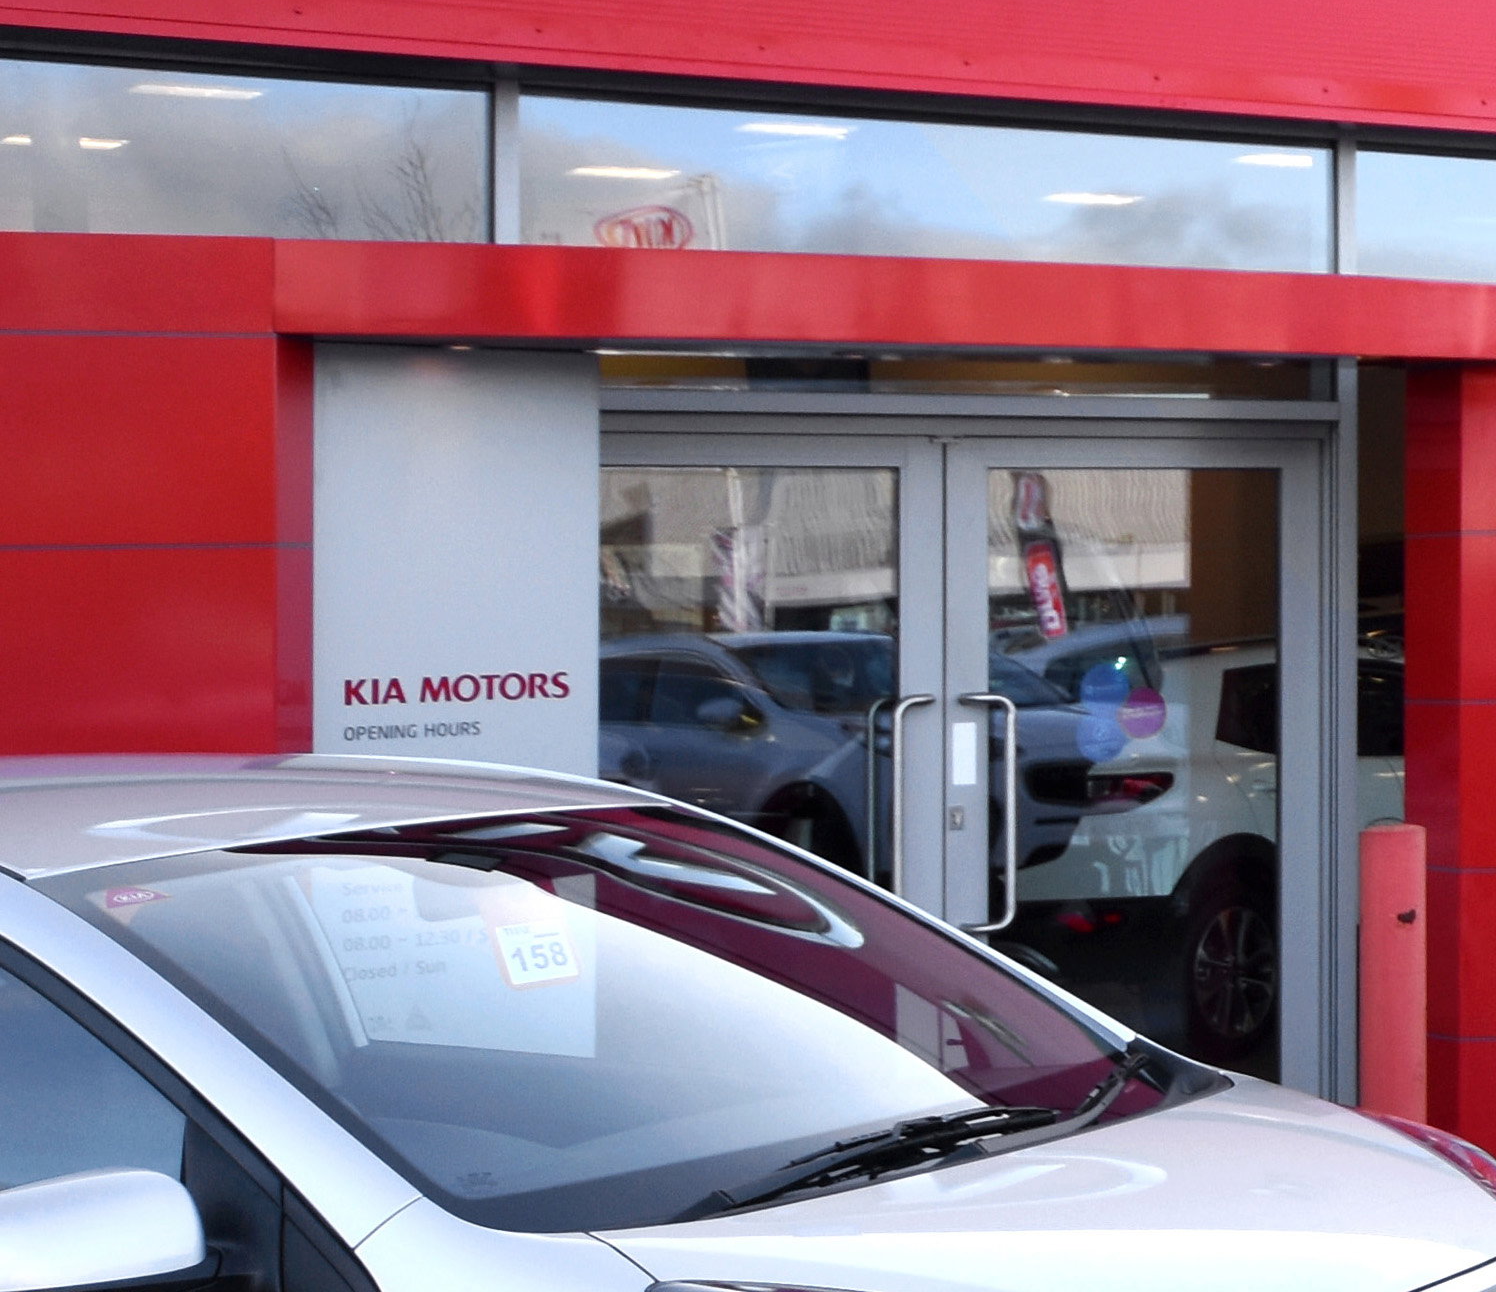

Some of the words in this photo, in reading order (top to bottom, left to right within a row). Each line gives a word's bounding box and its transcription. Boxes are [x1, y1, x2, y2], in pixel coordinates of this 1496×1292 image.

[343, 678, 407, 706] KIA
[419, 671, 570, 703] MOTORS
[343, 723, 418, 741] OPENING
[423, 721, 482, 738] HOURS
[416, 960, 447, 975] Sun
[511, 941, 568, 972] 158
